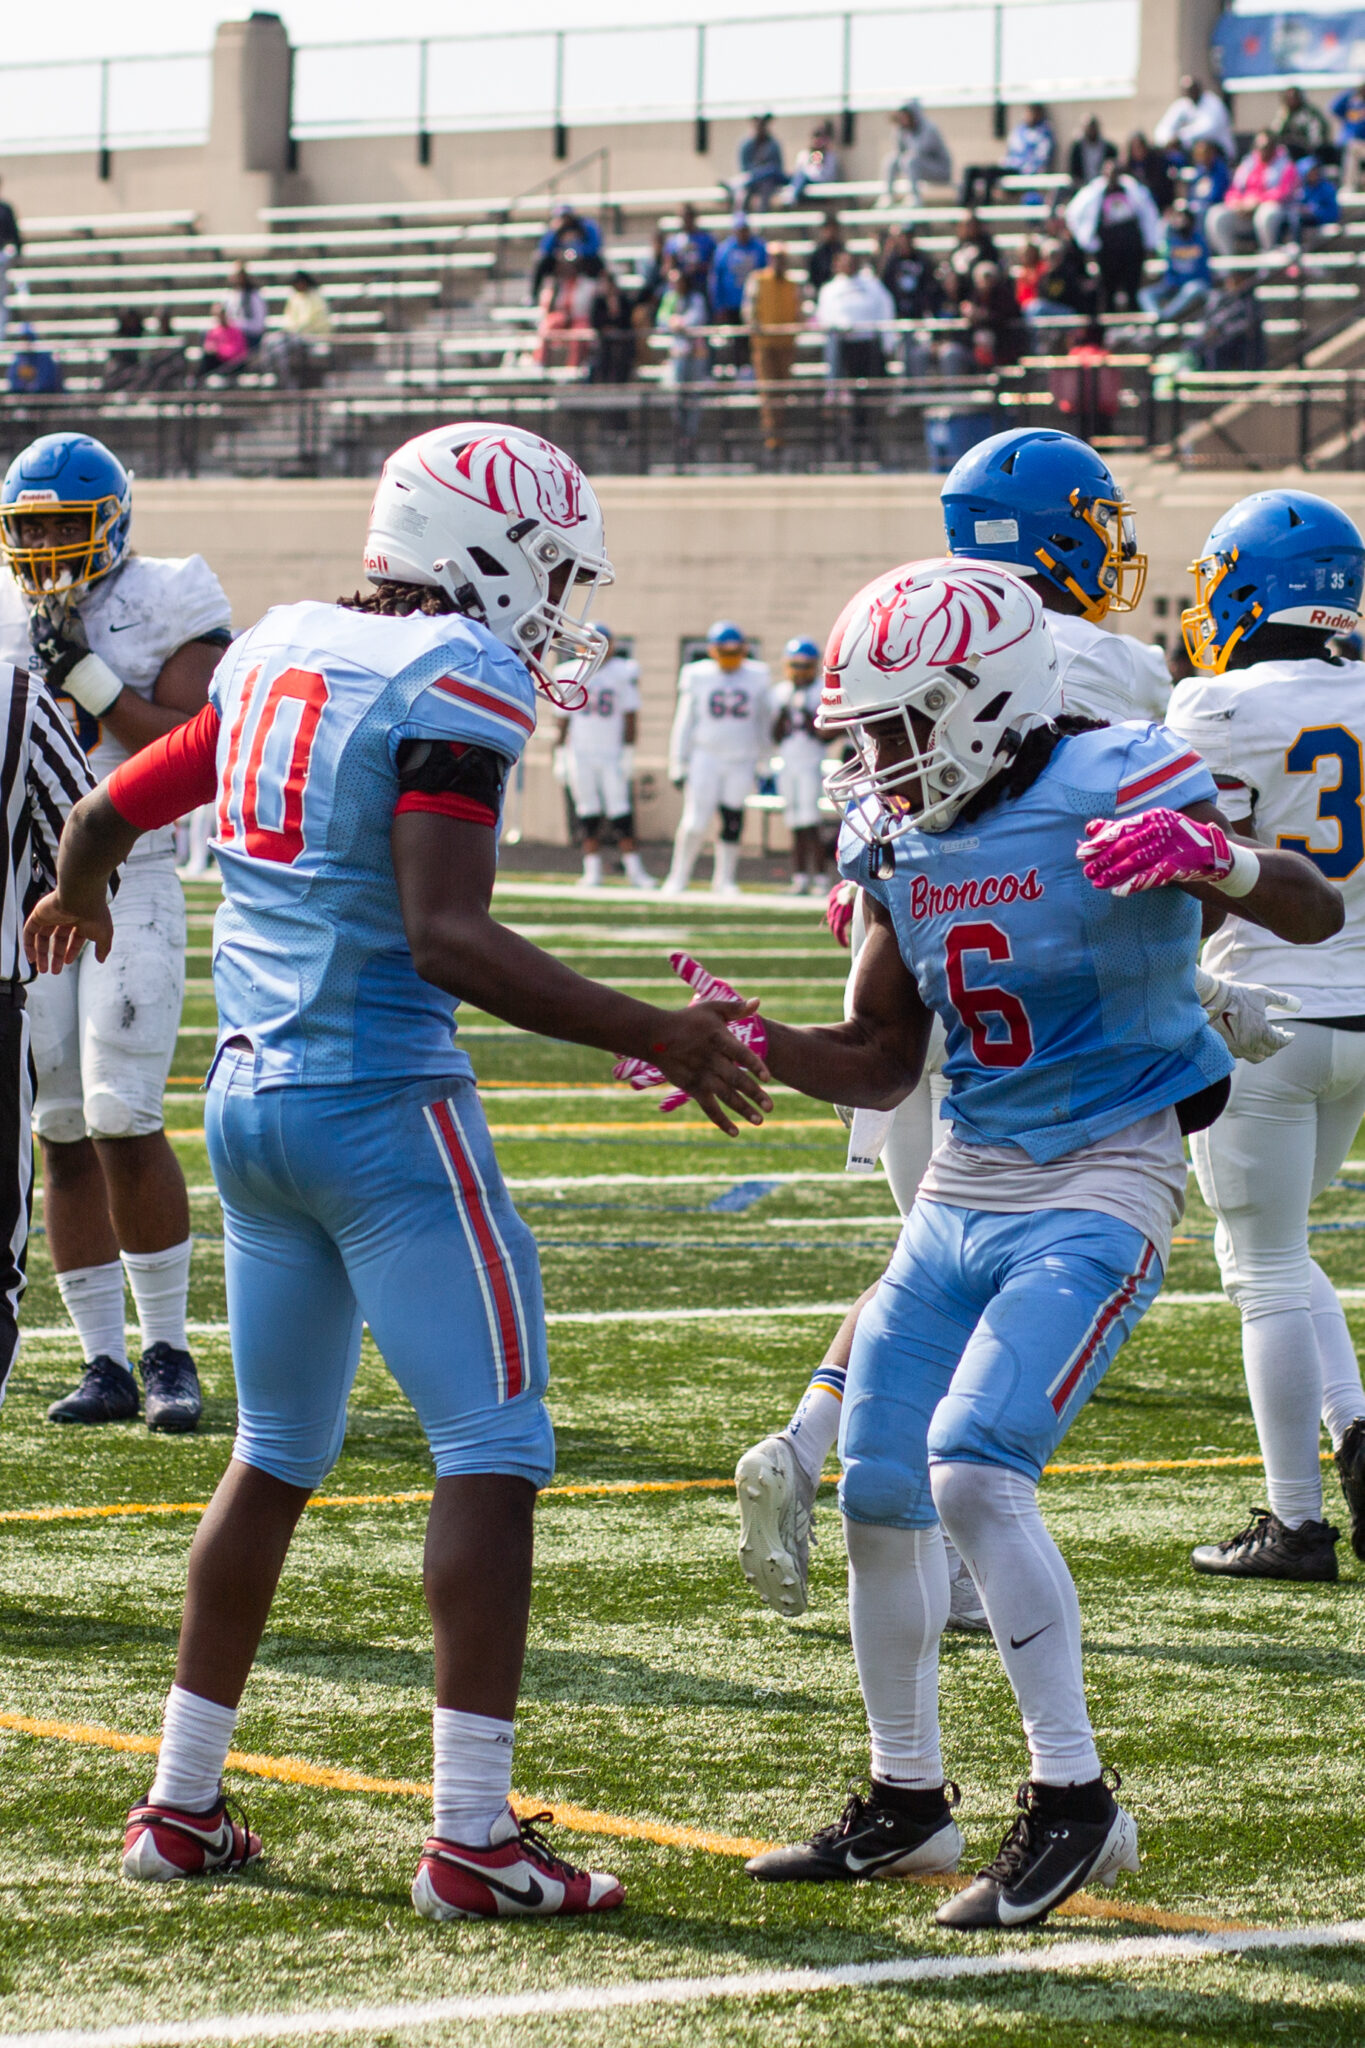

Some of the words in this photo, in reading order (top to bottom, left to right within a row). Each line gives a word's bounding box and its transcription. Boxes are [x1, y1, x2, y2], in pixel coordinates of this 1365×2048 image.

[1330, 572, 1345, 589] 35
[708, 689, 749, 718] 62
[218, 663, 332, 867] 10
[910, 867, 1045, 921] Broncos
[944, 920, 1035, 1069] 6
